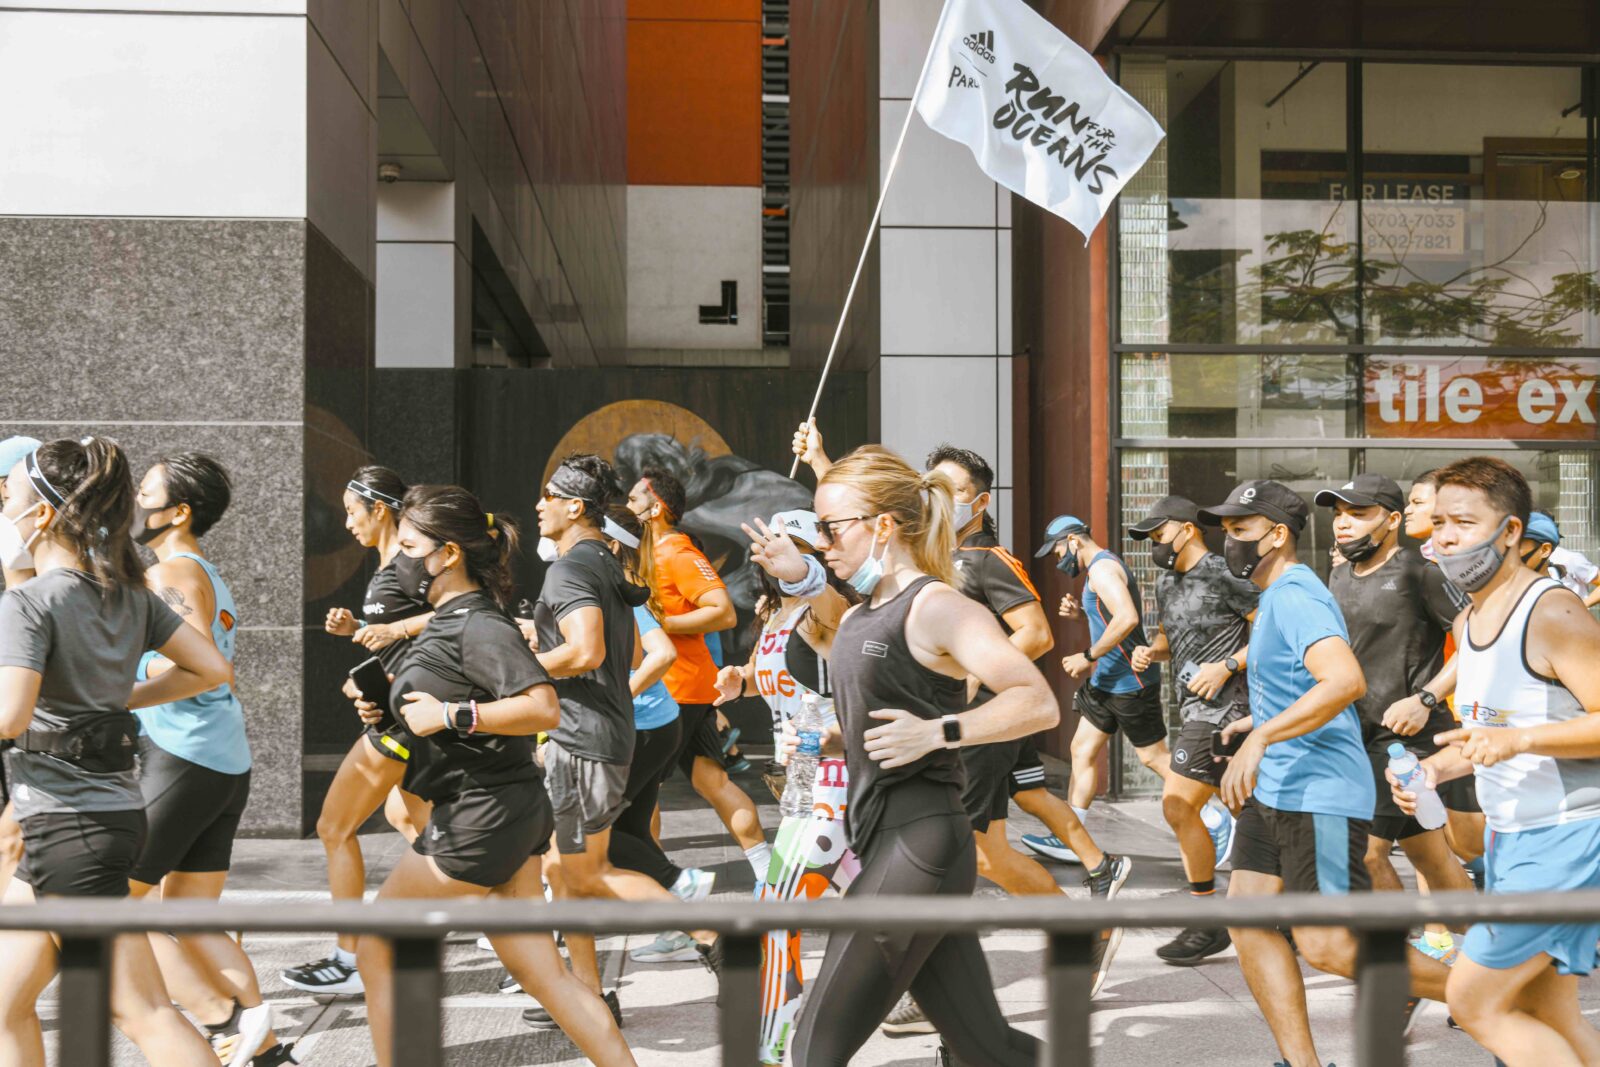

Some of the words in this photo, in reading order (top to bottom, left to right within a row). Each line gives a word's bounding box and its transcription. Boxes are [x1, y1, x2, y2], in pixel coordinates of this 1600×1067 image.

[962, 36, 996, 64] adidas
[1005, 63, 1090, 136] RUN
[993, 99, 1118, 195] OCEANS
[1084, 135, 1112, 154] THE
[1086, 121, 1116, 146] FOR
[1329, 184, 1376, 204] FR
[1384, 184, 1454, 204] LEASE
[1375, 364, 1484, 424] tile
[1517, 377, 1597, 424] ex
